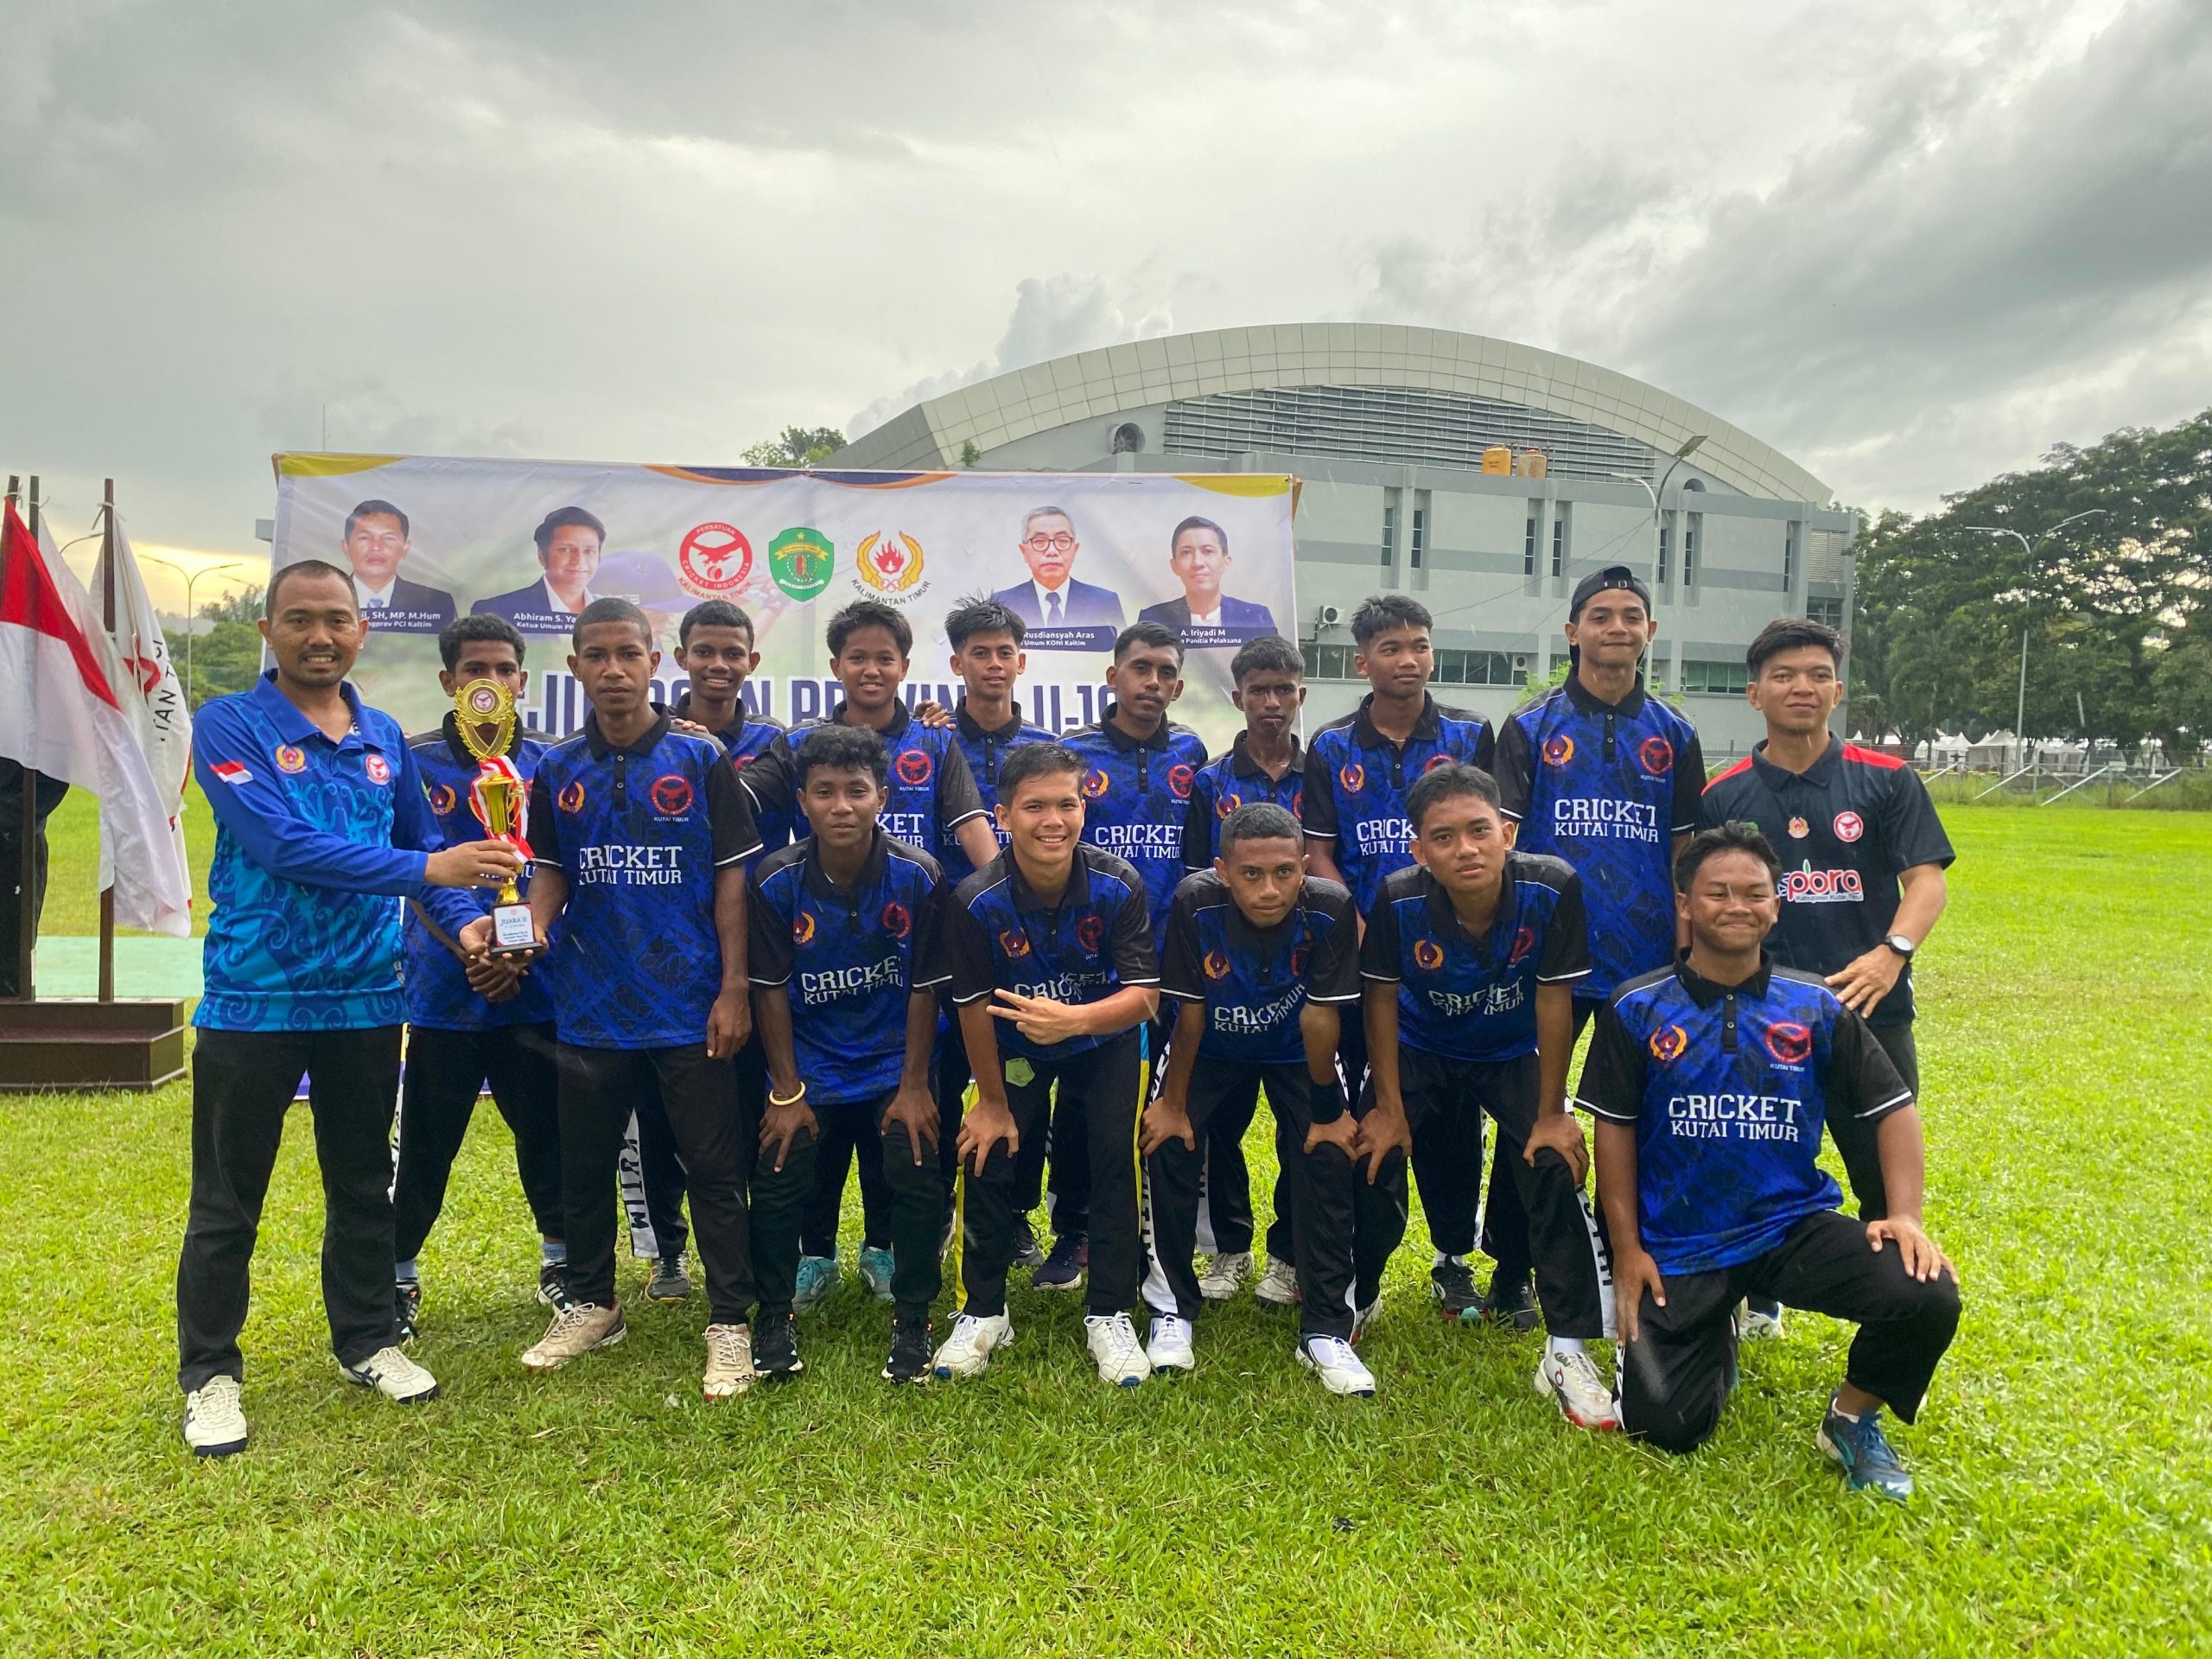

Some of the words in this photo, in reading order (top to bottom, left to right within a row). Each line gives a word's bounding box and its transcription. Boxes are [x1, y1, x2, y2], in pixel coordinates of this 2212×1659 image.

[696, 524, 736, 535] PERSATUAN
[682, 560, 709, 588] CRICKET
[714, 562, 750, 588] INDONESIA
[678, 577, 728, 601] KALIMANTAN
[729, 582, 753, 600] TIMUR
[851, 579, 906, 605] KALIMANTAN
[907, 581, 931, 601] TIMUR
[513, 613, 553, 622] Abhiram
[1023, 632, 1074, 640] Rusdiansyah
[1191, 629, 1217, 638] Iriyadi
[1554, 798, 1656, 827] CRICKET
[1095, 823, 1184, 845] CRICKET
[1356, 818, 1418, 842] CRICK
[1554, 822, 1609, 836] KUTAI
[579, 844, 683, 869] CRICKET
[1104, 845, 1139, 858] UTAI
[1360, 840, 1394, 855] KUTAI
[623, 869, 683, 885] TIMUR
[801, 956, 903, 992] CRICKE
[864, 974, 904, 994] TIMU
[1669, 1094, 1801, 1123] CRICKET
[1670, 1120, 1727, 1138] KUTAI
[1735, 1122, 1798, 1142] TIMUR
